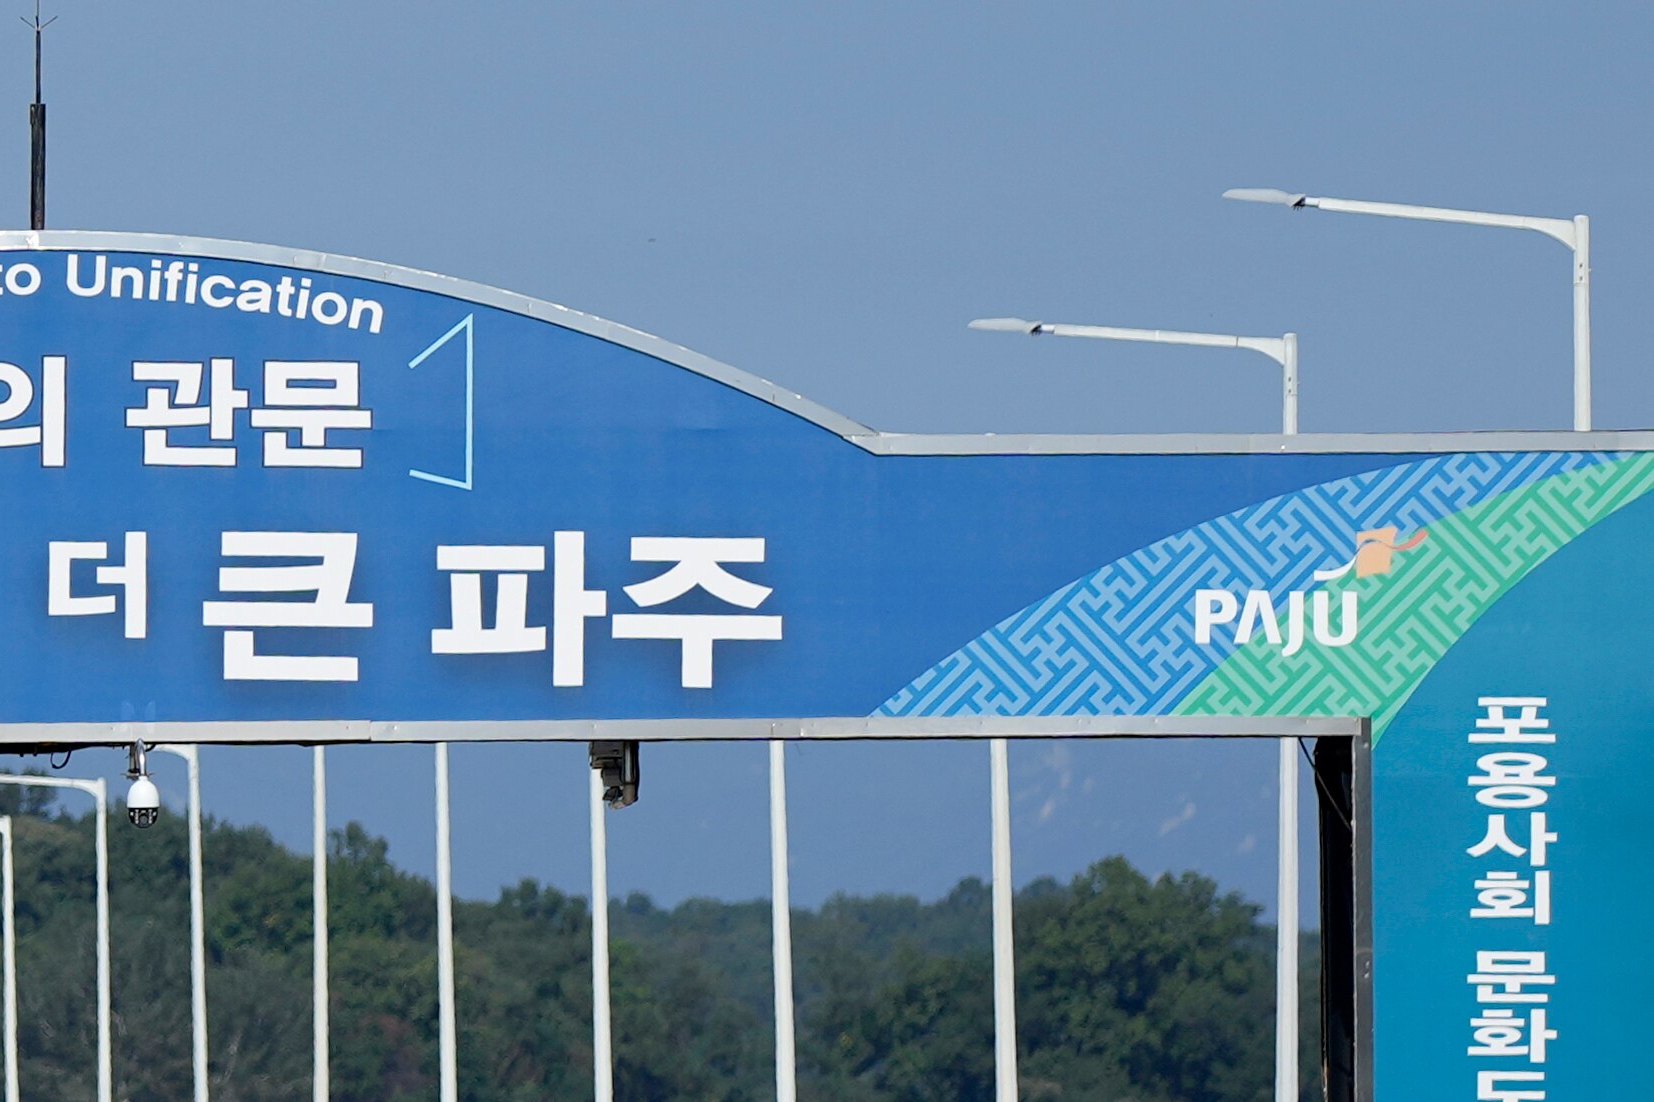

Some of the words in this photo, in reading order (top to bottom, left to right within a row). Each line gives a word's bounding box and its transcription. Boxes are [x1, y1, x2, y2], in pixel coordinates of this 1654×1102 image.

[66, 254, 386, 335] Unification
[125, 356, 373, 468] 관문
[48, 531, 147, 639] 더
[202, 531, 374, 682] 큰
[431, 530, 783, 688] 파주
[1194, 588, 1358, 657] PAJU
[1466, 696, 1558, 925] 포용사회
